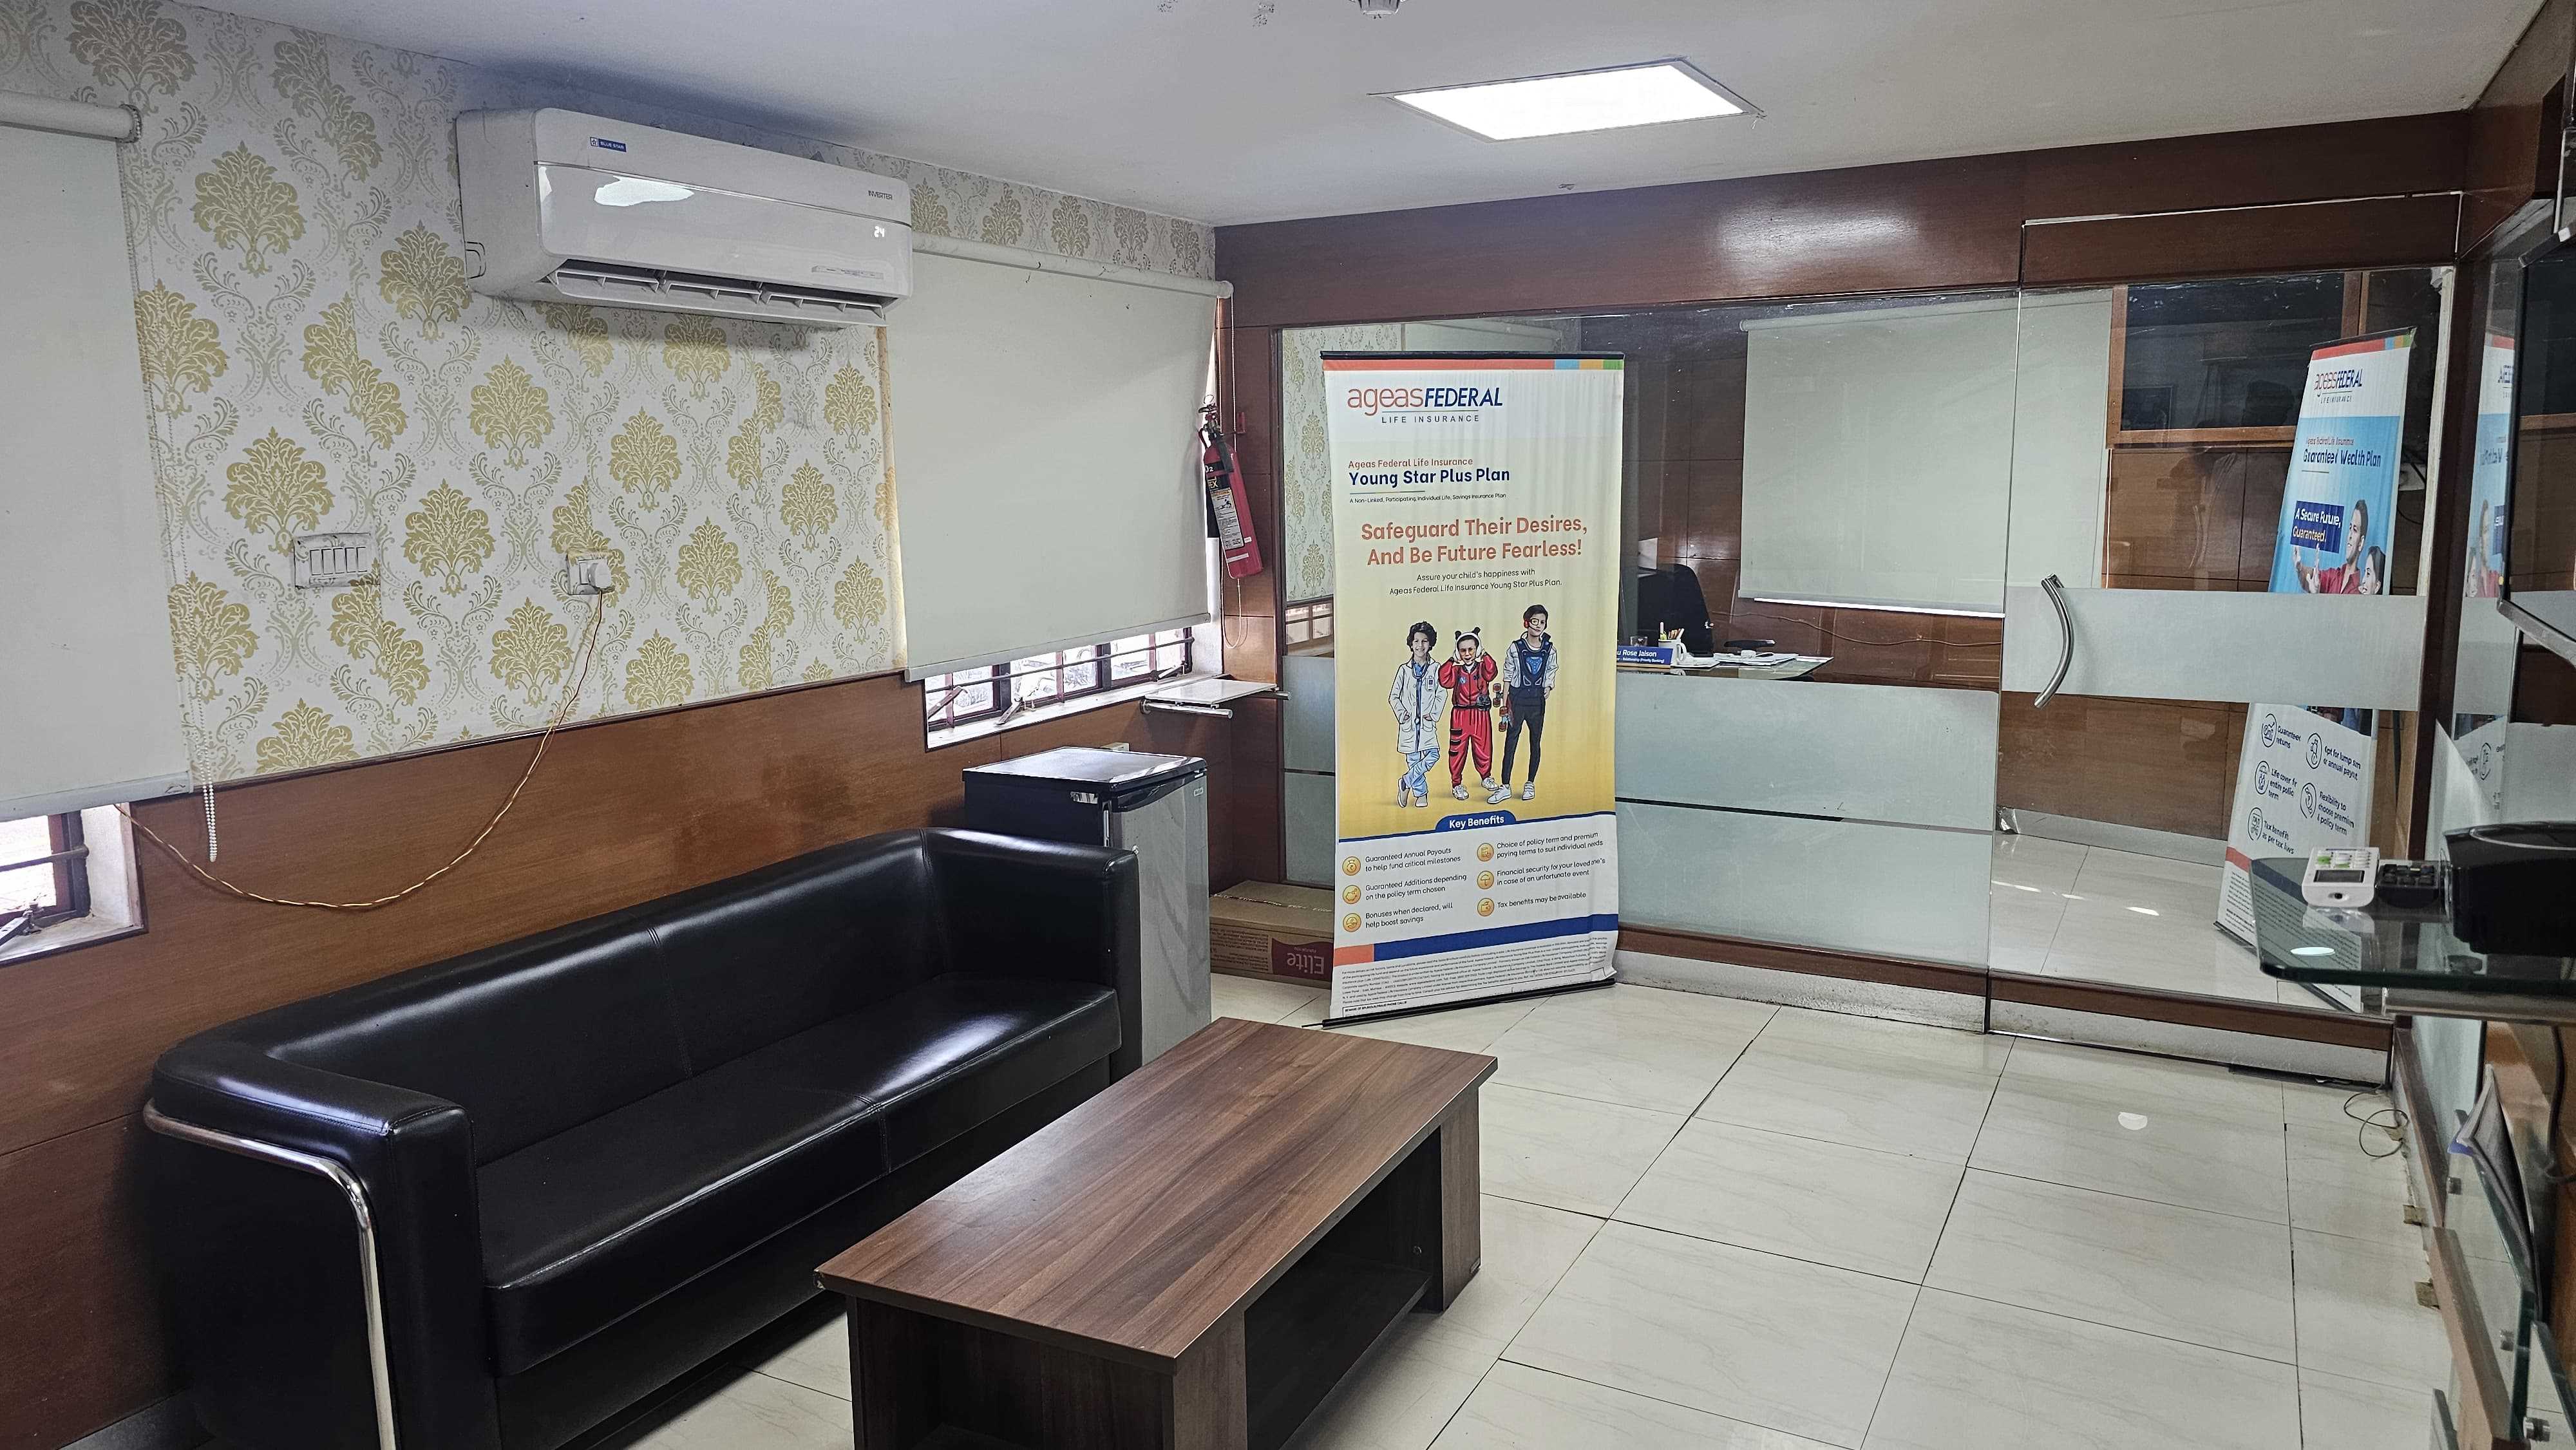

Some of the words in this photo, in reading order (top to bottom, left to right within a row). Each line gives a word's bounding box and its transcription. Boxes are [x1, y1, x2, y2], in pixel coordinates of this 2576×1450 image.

[867, 190, 893, 200] INVERTER
[874, 226, 884, 237] 24
[1349, 460, 1376, 469] Ageas
[1378, 459, 1410, 467] Federal
[1414, 458, 1429, 467] Life
[2340, 449, 2365, 466] Wealth
[2365, 450, 2382, 467] Plan
[1349, 472, 1398, 488] Young
[1403, 470, 1436, 484] Star
[1441, 469, 1472, 483] Plus
[1476, 467, 1510, 482] Plan
[2295, 507, 2300, 520] A
[2300, 508, 2320, 523] Secure
[1361, 519, 1459, 543] Safeguard
[1464, 517, 1511, 536] Their
[1517, 514, 1587, 534] Desires,
[1367, 547, 1404, 565] And
[1410, 547, 1432, 563] Be
[1437, 545, 1497, 562] Future
[1502, 539, 1582, 559] Fearless!
[1442, 574, 1458, 582] your
[1483, 570, 1519, 579] happiness
[1449, 820, 1466, 830] Key
[1468, 815, 1504, 827] Benefits
[1526, 838, 1544, 847] policy
[1365, 852, 1403, 863] Guaranteed
[1403, 850, 1426, 860] Annual
[1426, 848, 1452, 857] Payouts
[1497, 851, 1518, 859] paying
[1557, 842, 1586, 851] individual
[1388, 862, 1403, 870] fund
[1405, 858, 1426, 867] critical
[1426, 856, 1461, 865] milestones
[1497, 868, 1525, 876] Financial
[1526, 864, 1549, 872] security
[1574, 859, 1591, 867] loved
[1365, 881, 1403, 891] Guaranteed
[1404, 878, 1433, 887] Additions
[1434, 874, 1467, 883] depending
[1536, 872, 1571, 881] unfortunate
[1387, 890, 1406, 899] policy
[1509, 898, 1534, 907] benefits
[1557, 892, 1586, 901] available
[1365, 911, 1392, 919] Bonuses
[1411, 904, 1441, 913] declared,
[1399, 916, 1424, 925] savings
[1287, 952, 1324, 975] Elite
